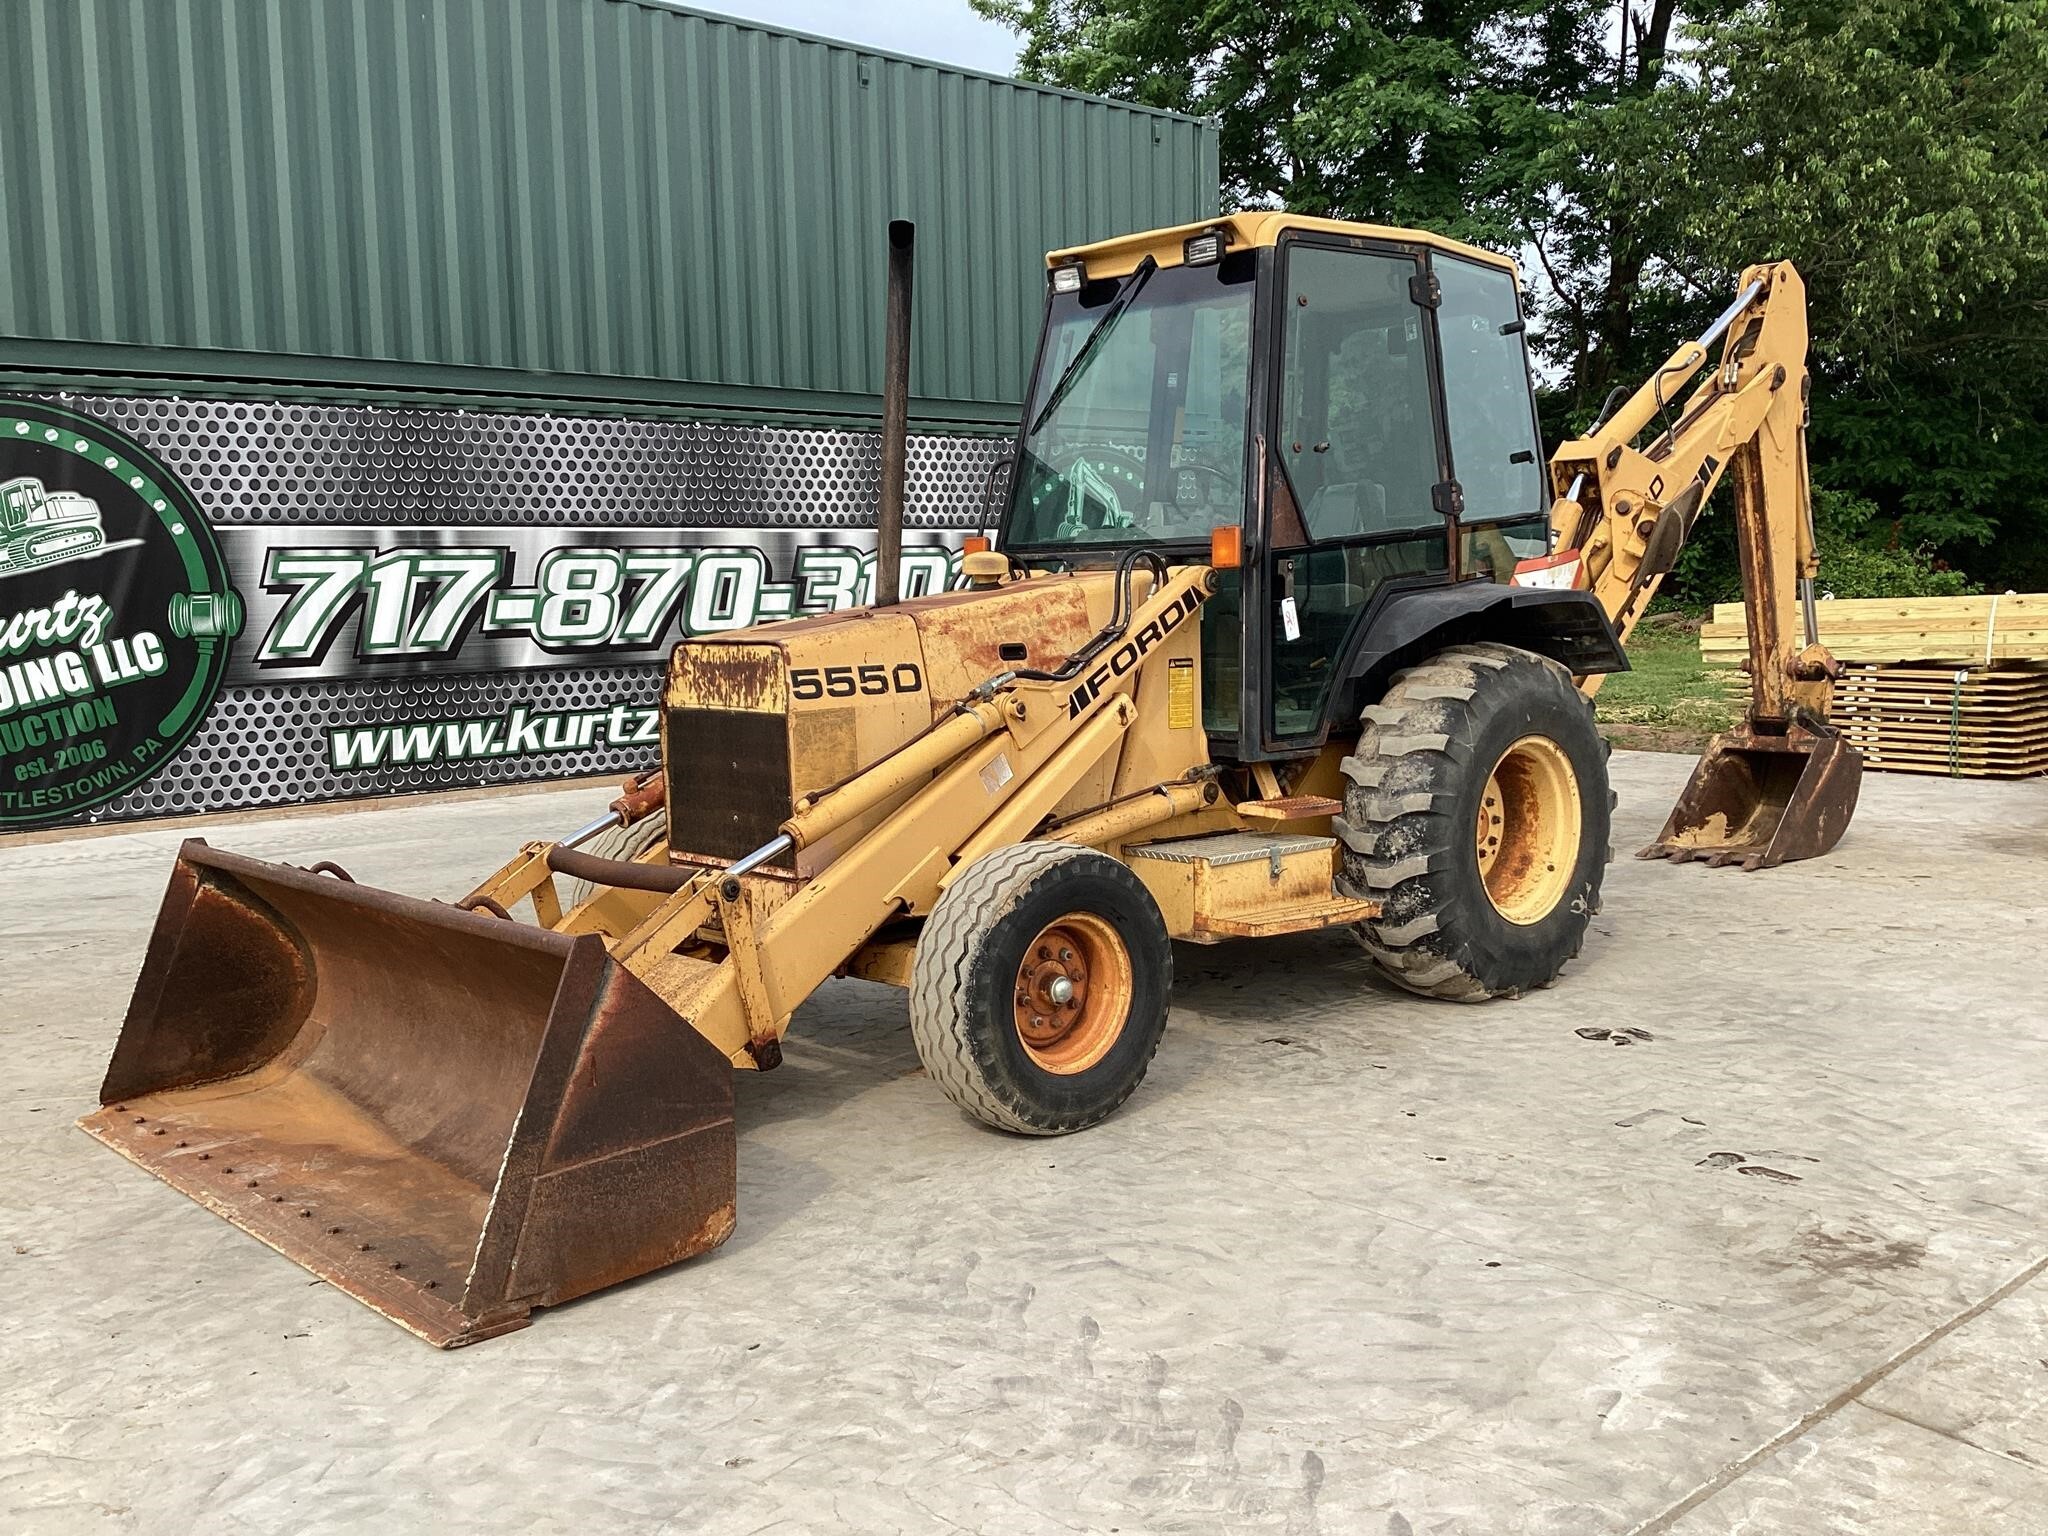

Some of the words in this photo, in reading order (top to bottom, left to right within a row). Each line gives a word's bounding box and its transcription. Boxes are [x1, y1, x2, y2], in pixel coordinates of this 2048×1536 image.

[0, 590, 111, 652] urtz
[1086, 600, 1185, 699] FORD
[92, 632, 165, 685] LLC
[790, 663, 922, 700] 555D
[0, 760, 136, 809] TLESTOWN,
[133, 738, 163, 763] PA
[15, 757, 54, 781] est.
[54, 740, 107, 771] 2006
